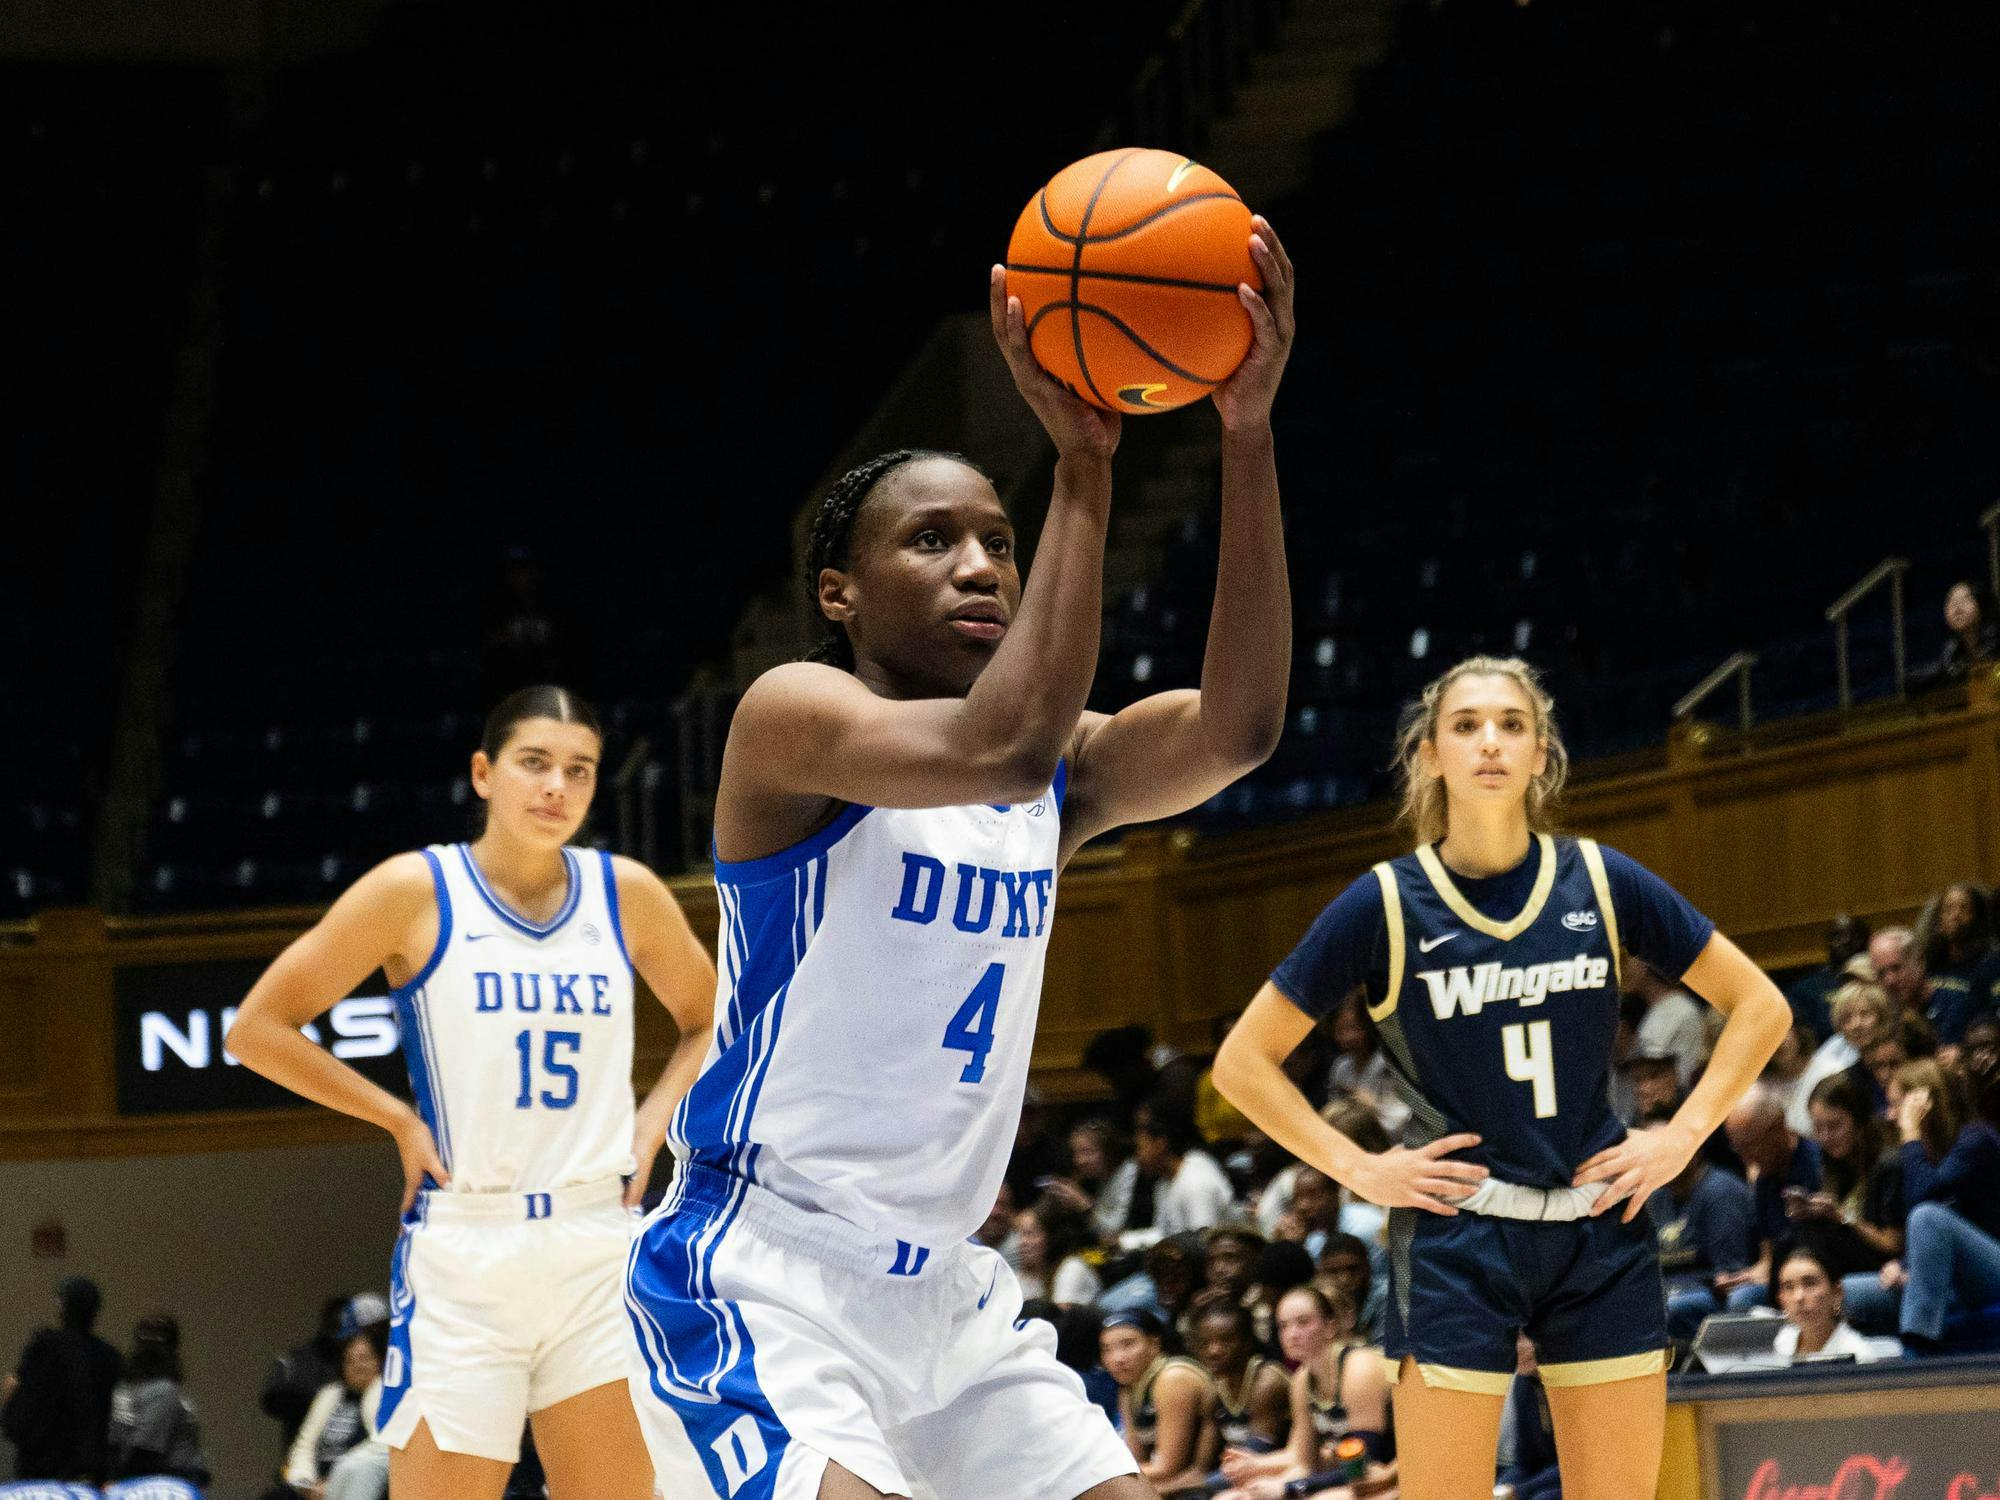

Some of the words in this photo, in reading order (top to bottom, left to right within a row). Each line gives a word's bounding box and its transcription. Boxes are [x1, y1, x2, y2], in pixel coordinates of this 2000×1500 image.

[891, 852, 1053, 938] DUKE
[474, 971, 612, 1016] DUKE
[943, 962, 1005, 1083] 4
[1416, 953, 1609, 1020] Wingate
[515, 1029, 581, 1110] 15
[1502, 1019, 1557, 1119] 4
[710, 1414, 768, 1499] D
